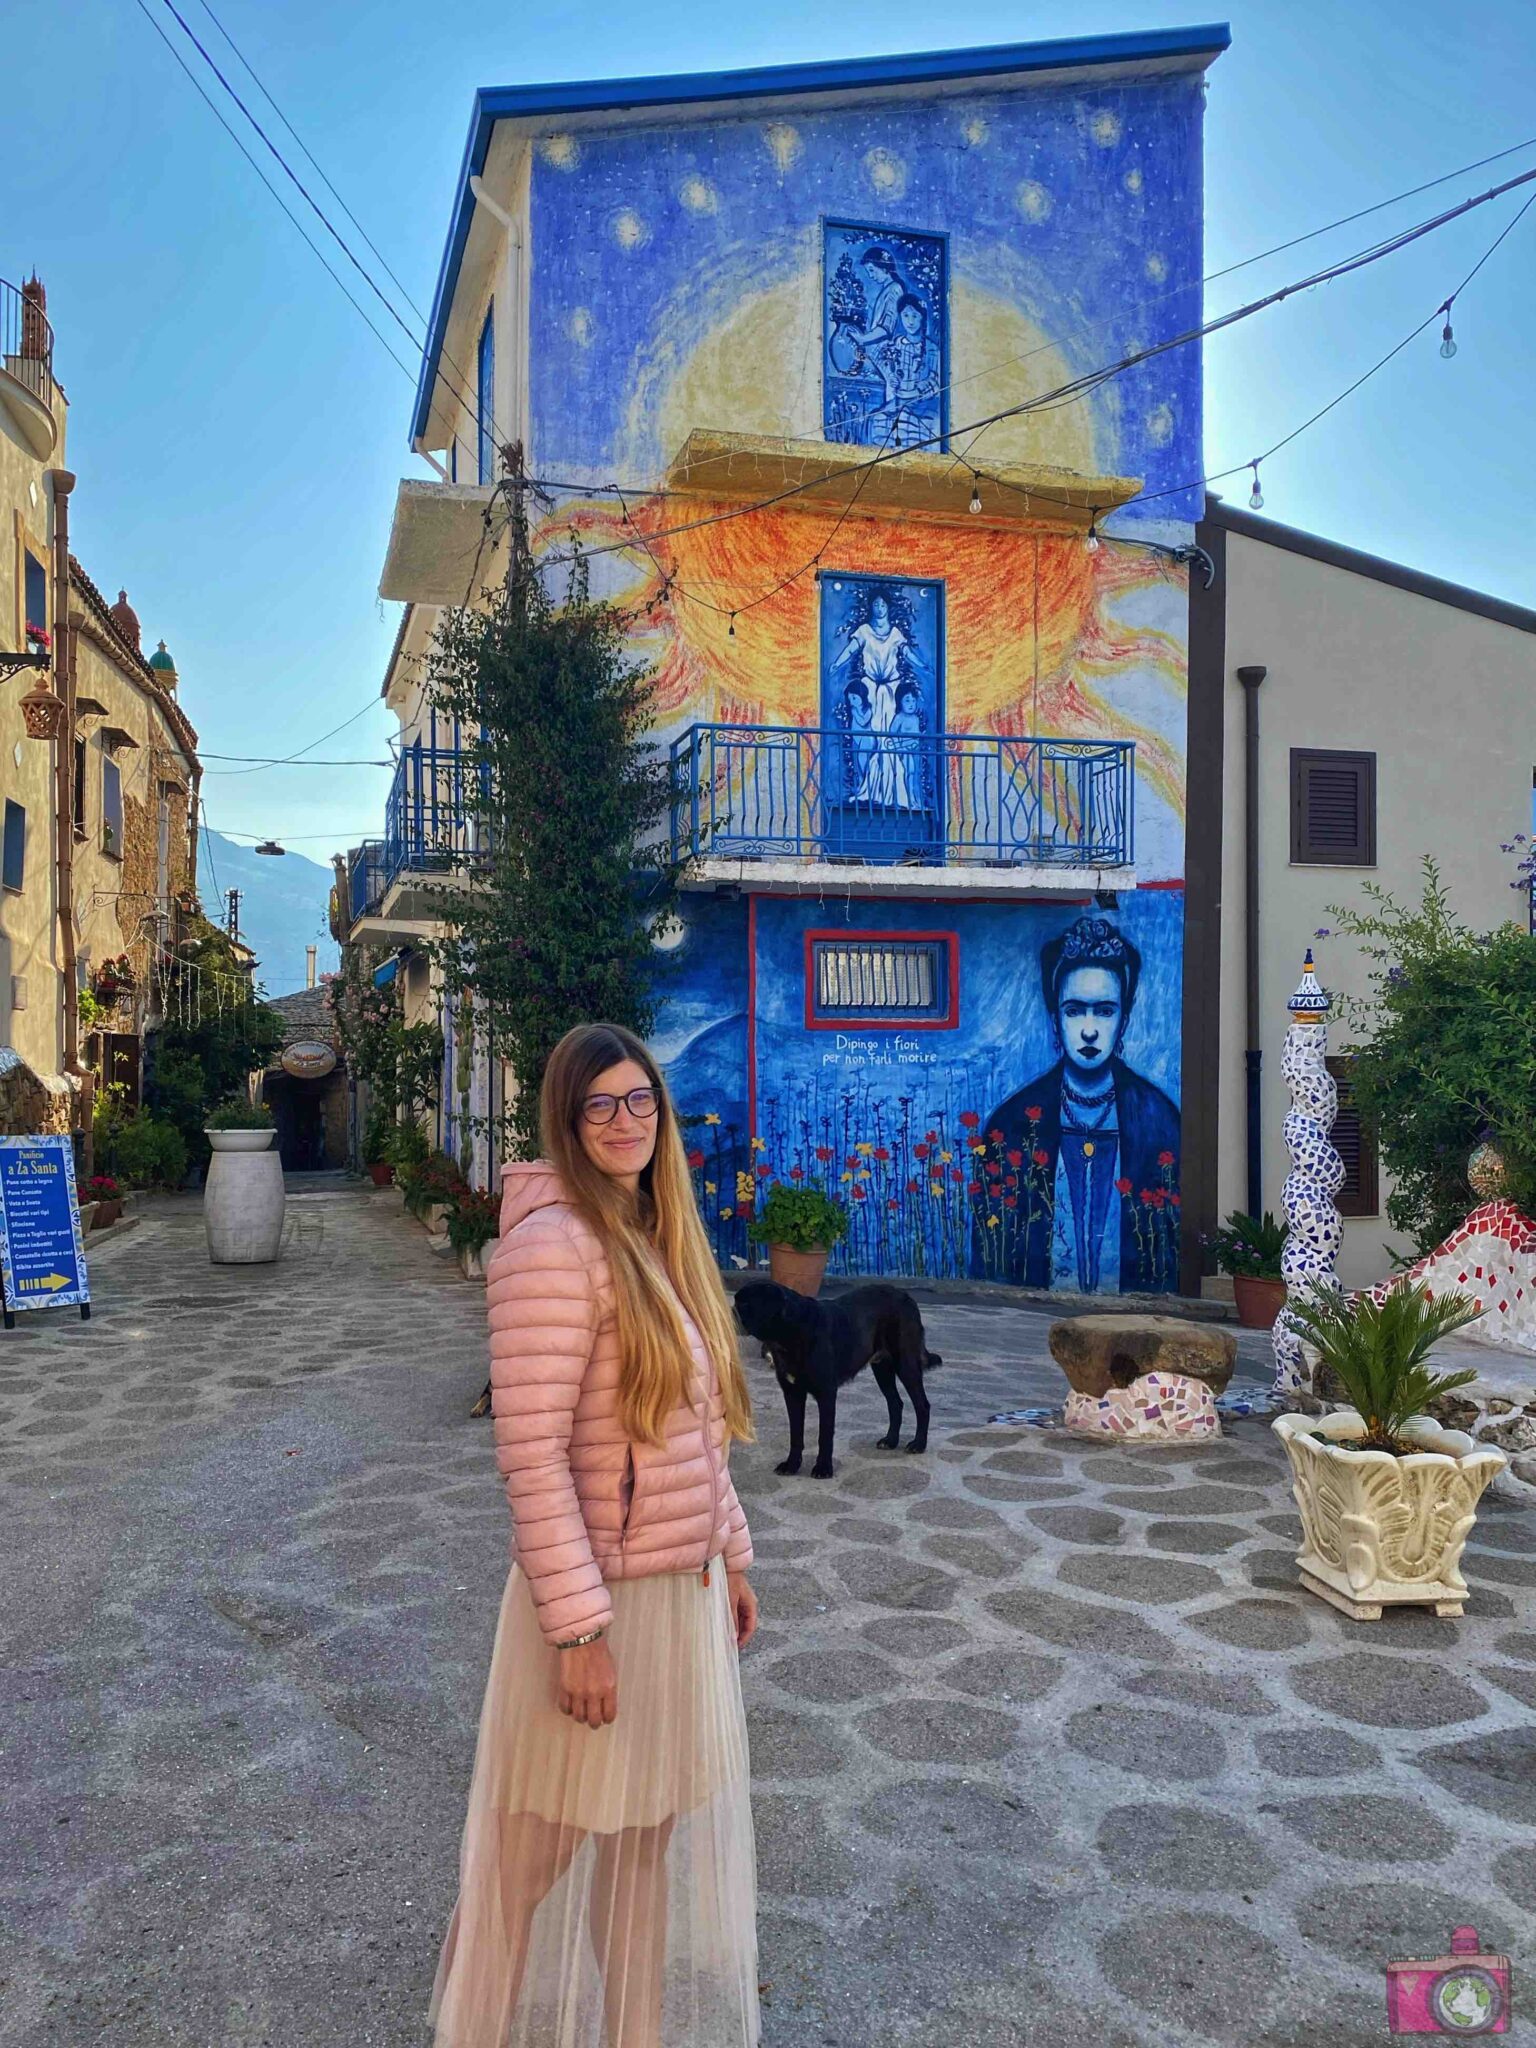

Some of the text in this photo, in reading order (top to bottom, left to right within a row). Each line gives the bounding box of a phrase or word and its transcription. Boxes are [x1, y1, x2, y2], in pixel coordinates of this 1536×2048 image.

[836, 1034, 920, 1055] Dipingo i fiori
[822, 1049, 937, 1067] per non farli morire
[18, 1150, 44, 1160] Panificio
[8, 1160, 58, 1176] a Za Santa
